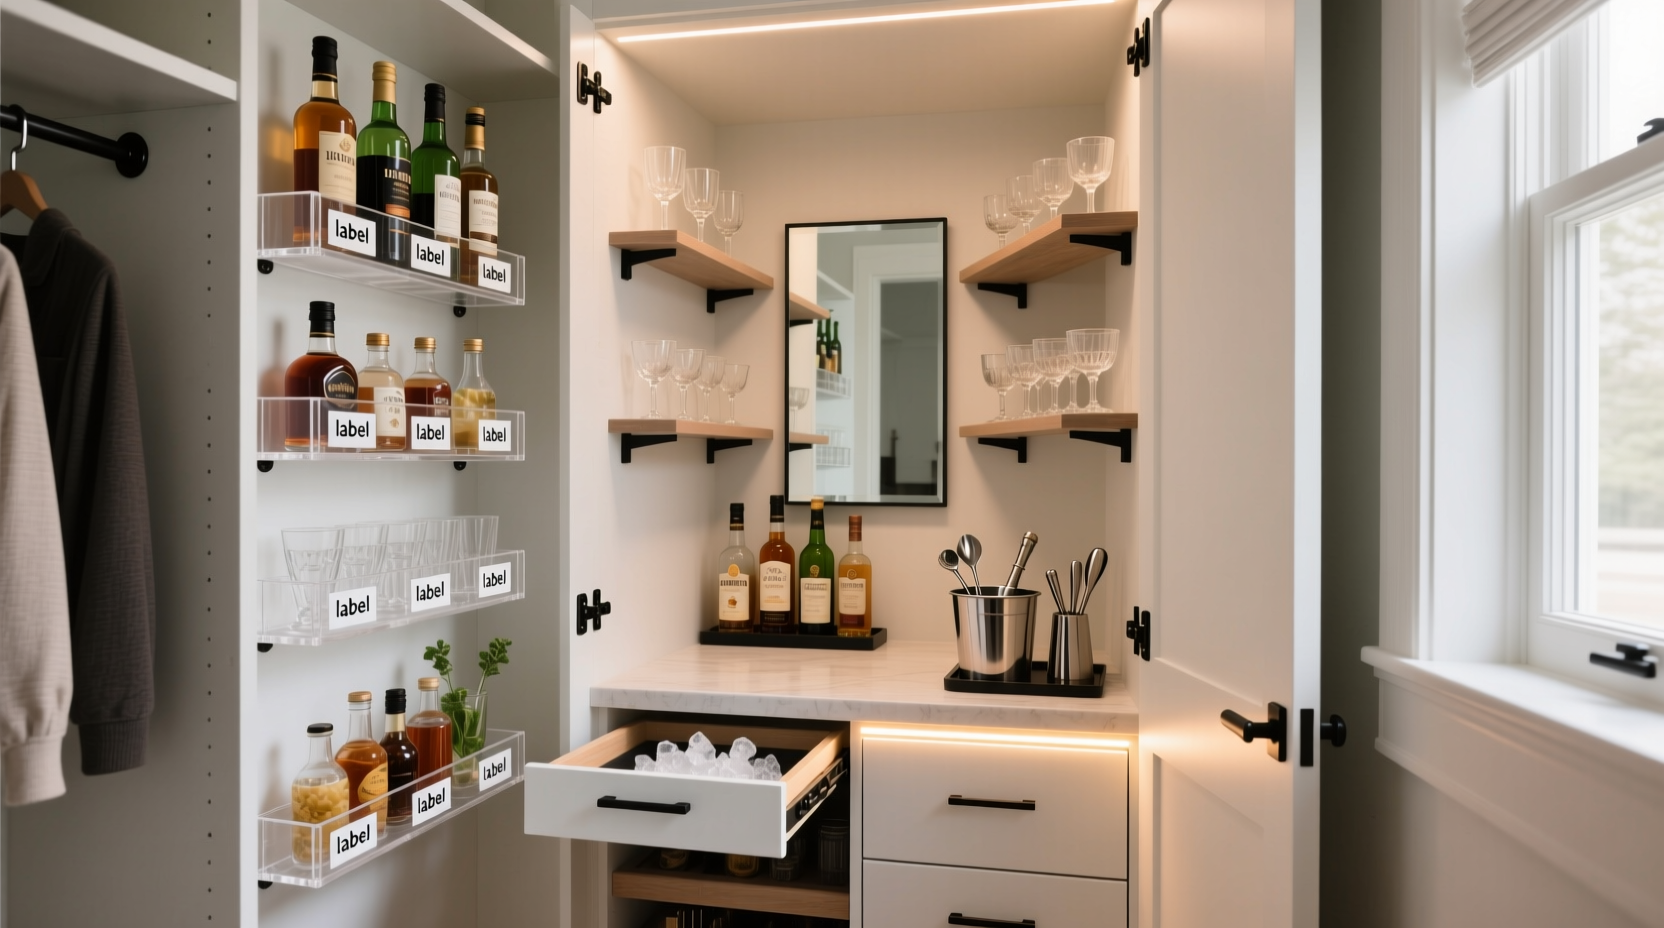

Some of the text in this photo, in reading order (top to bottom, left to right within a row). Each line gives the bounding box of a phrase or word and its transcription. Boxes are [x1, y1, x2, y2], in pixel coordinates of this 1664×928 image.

[335, 218, 369, 244] label
[416, 243, 445, 266] label
[483, 263, 506, 283] label
[335, 419, 369, 438] label
[416, 423, 445, 441] label
[483, 426, 507, 442] label
[483, 569, 506, 589] label
[416, 580, 445, 602] label
[336, 594, 370, 618] label
[483, 756, 506, 781] label
[417, 787, 446, 814] label
[337, 823, 370, 855] label
